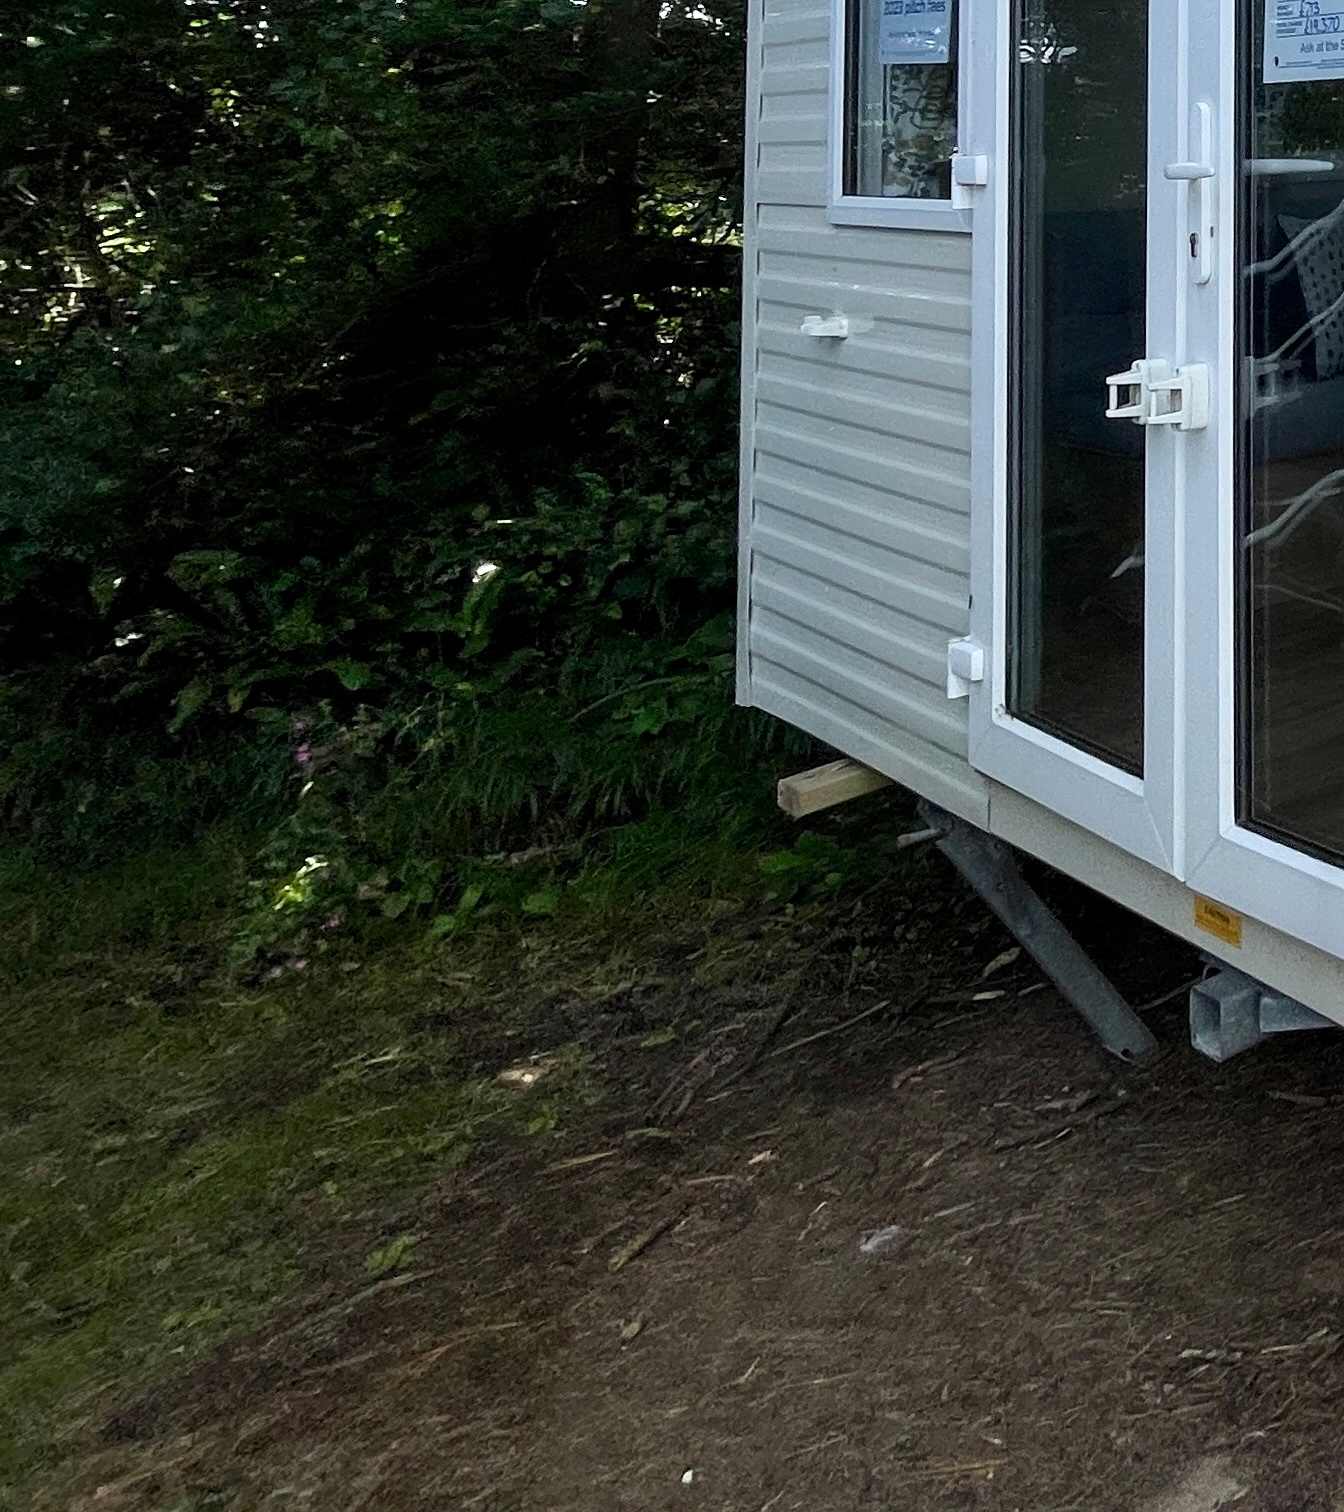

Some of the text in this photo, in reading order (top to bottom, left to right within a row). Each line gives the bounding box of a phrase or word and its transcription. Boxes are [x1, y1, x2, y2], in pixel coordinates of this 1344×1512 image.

[1300, 42, 1314, 54] Ask
[1315, 41, 1324, 52] at
[1326, 40, 1339, 51] the
